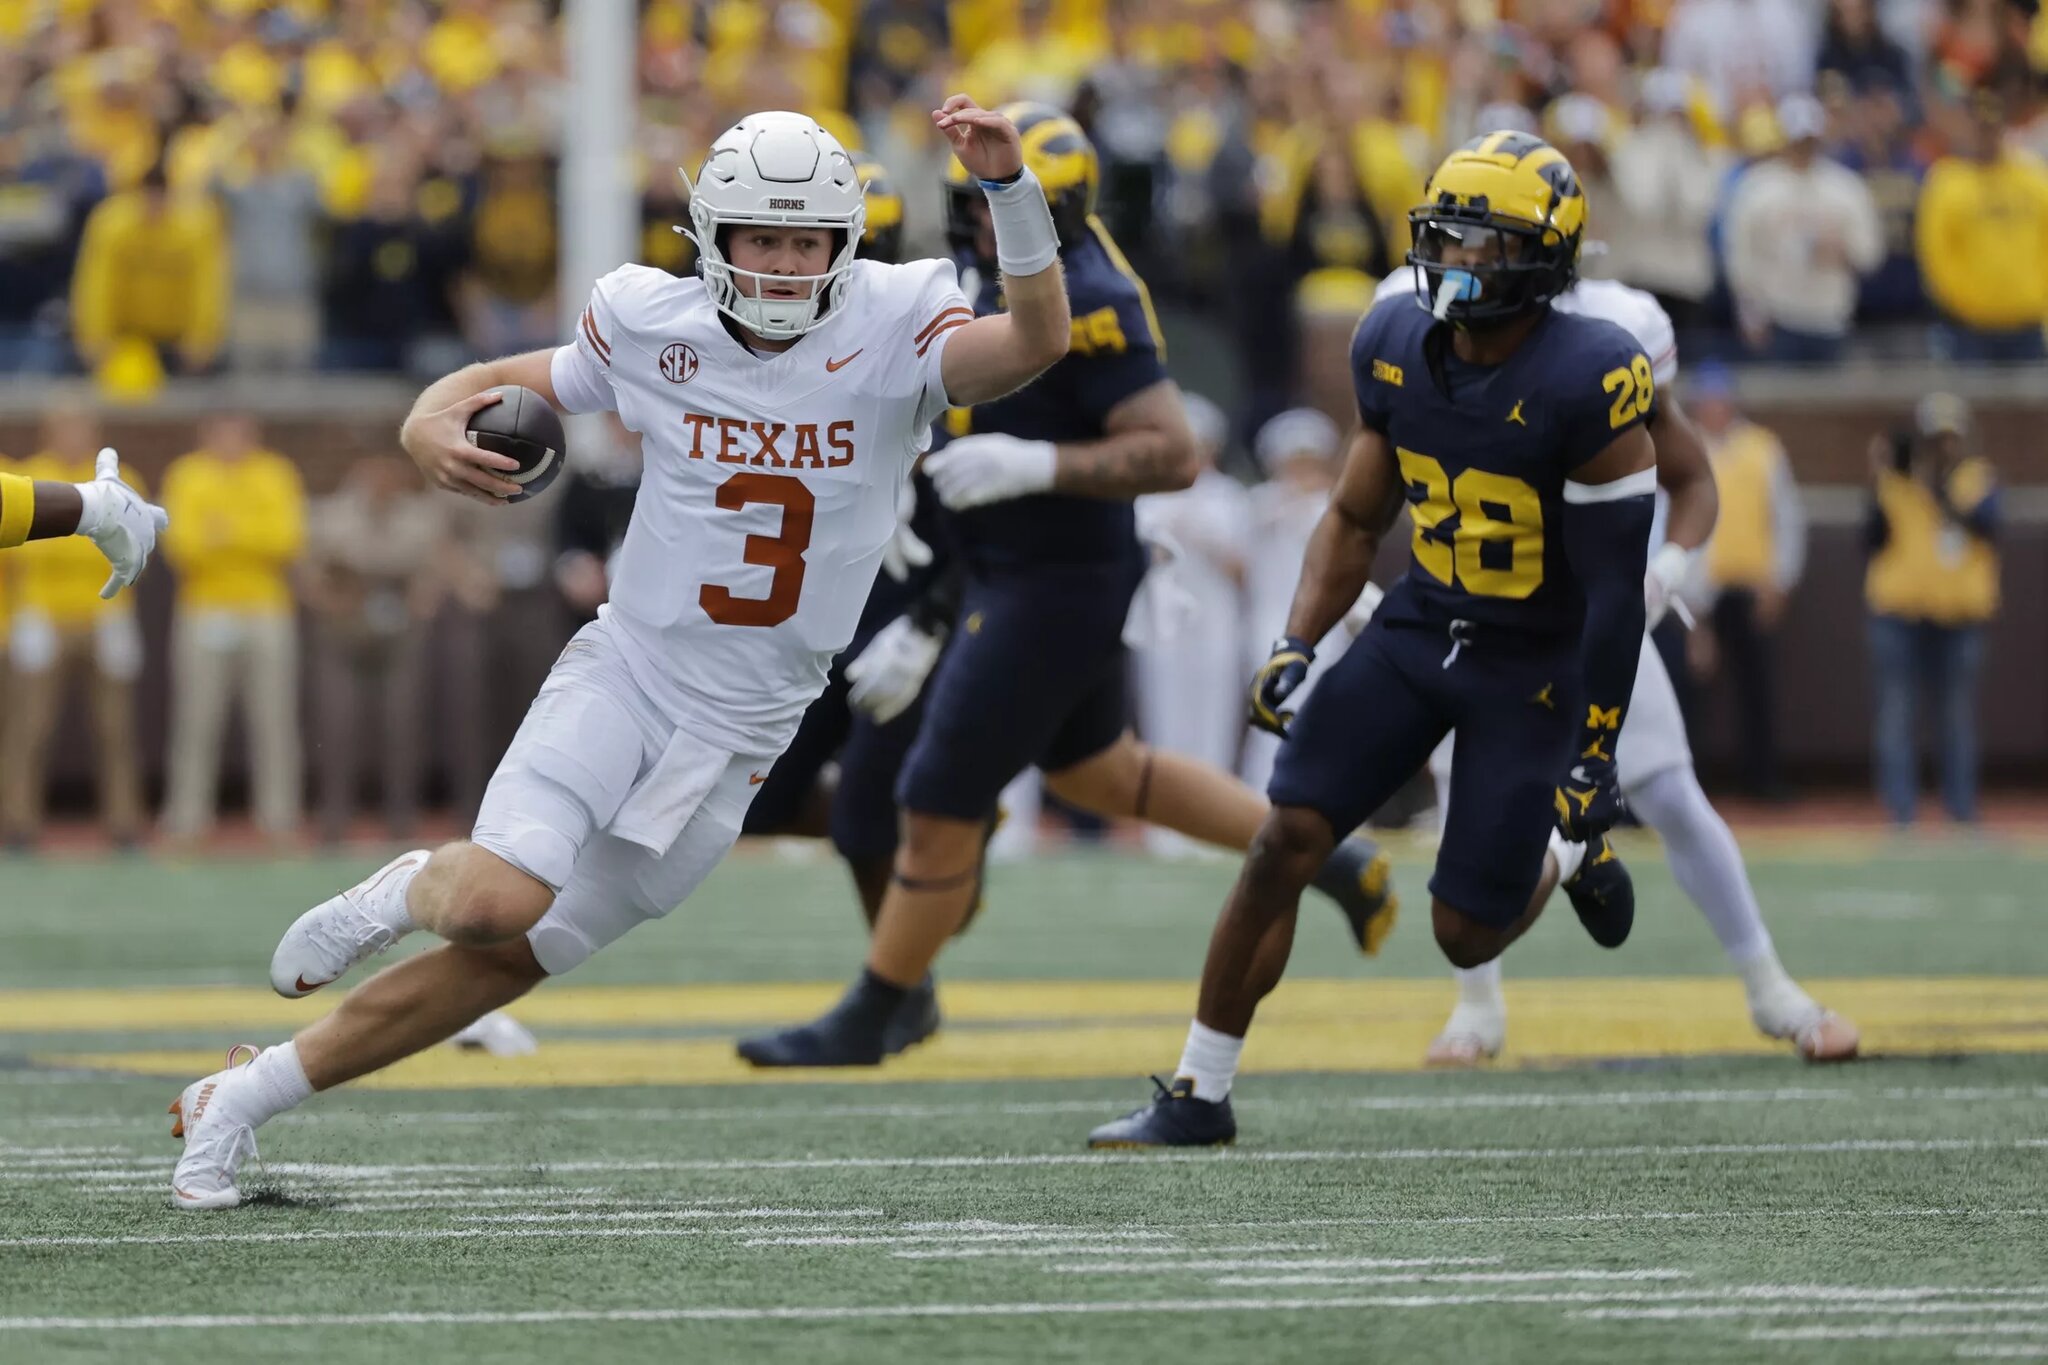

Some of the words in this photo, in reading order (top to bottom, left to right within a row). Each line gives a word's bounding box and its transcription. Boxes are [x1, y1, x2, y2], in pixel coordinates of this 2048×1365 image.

[769, 198, 805, 210] HORNS
[660, 344, 698, 383] SEC
[1602, 353, 1654, 430] 28
[683, 412, 854, 469] TEXAS
[698, 472, 815, 628] 3
[1396, 446, 1544, 599] 28
[1587, 703, 1621, 730] M
